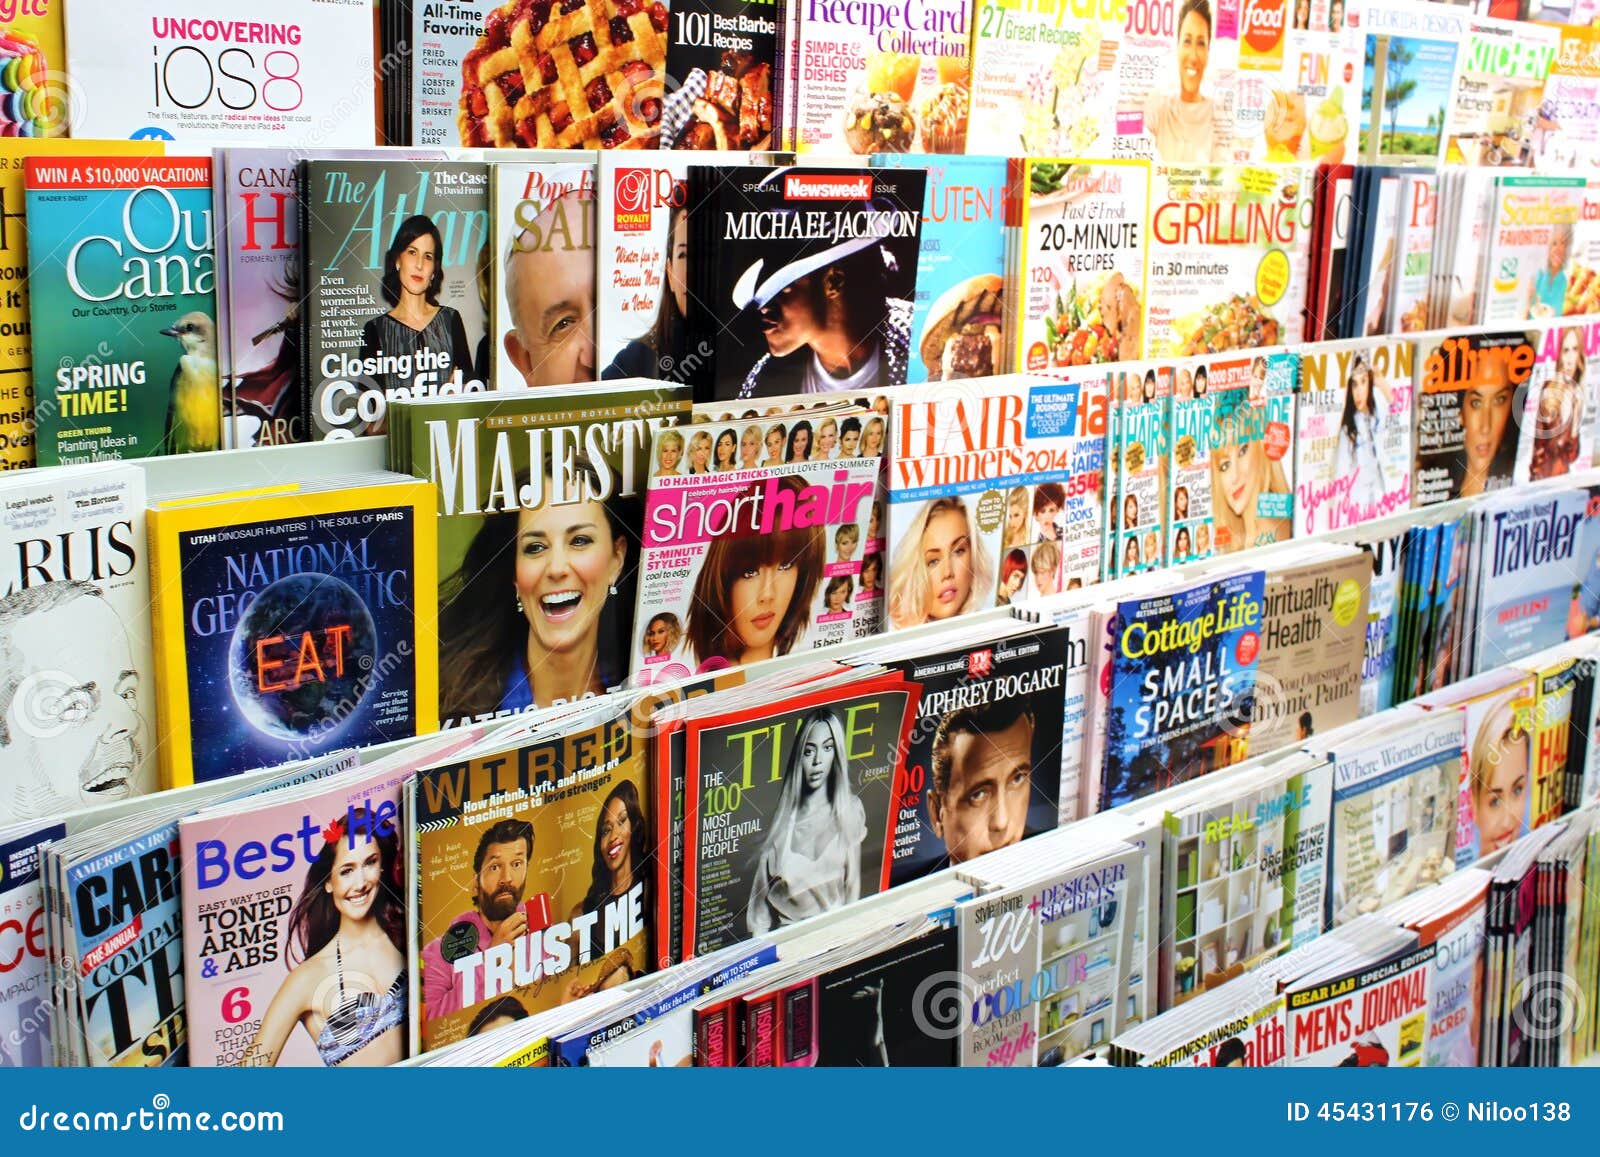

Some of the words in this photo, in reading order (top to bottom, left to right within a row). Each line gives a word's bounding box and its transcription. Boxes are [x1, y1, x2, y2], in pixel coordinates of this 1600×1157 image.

[423, 4, 483, 21] All-Time
[714, 14, 737, 32] Best
[807, 0, 900, 35] Recipe
[904, 0, 966, 35] Card
[980, 5, 1004, 39] 27
[1005, 23, 1036, 43] Great
[1037, 25, 1081, 47] Recipes
[1243, 1, 1285, 34] food
[1367, 7, 1419, 27] FLORIDA
[1423, 14, 1463, 34] DESIGN
[152, 16, 302, 45] UNCOVERING
[423, 20, 489, 38] Favorites
[674, 11, 711, 47] 101
[713, 33, 753, 51] Recipes
[877, 29, 966, 58] Collection
[423, 58, 458, 68] CHICKEN
[804, 54, 867, 71] DELICIOUS
[805, 40, 848, 55] SIMPLE
[1462, 36, 1555, 80] KITCHEN
[422, 78, 456, 88] LOBSTER
[804, 67, 847, 83] DISHES
[1298, 52, 1331, 85] FUN
[1458, 75, 1489, 93] Dream
[422, 108, 453, 117] BRISKET
[1456, 93, 1493, 113] Kitchens
[35, 167, 68, 184] WIN
[71, 168, 82, 184] A
[85, 166, 139, 184] $10,000
[142, 166, 209, 183] VACATION!
[323, 171, 366, 205] The
[520, 171, 571, 202] Pope
[742, 183, 780, 194] SPECIAL
[786, 176, 871, 199] Newsweek
[874, 184, 896, 194] ISSUE
[616, 213, 650, 224] ROYALTY
[724, 210, 829, 241] MICHAEL
[830, 210, 920, 244] JACKSON
[1061, 201, 1087, 221] Fast
[1098, 201, 1126, 221] Fresh
[1152, 202, 1296, 246] GRILLING
[1039, 222, 1138, 252] 20-MINUTE
[1031, 266, 1052, 284] 120
[1067, 253, 1115, 273] RECIPES
[1152, 262, 1164, 276] in
[1166, 262, 1182, 276] 30
[1184, 261, 1229, 276] minutes
[320, 275, 345, 286] Even
[320, 285, 369, 297] successful
[149, 301, 177, 313] Stories
[320, 295, 355, 306] women
[356, 294, 376, 306] lack
[320, 304, 386, 318] self-assurance
[342, 327, 365, 338] have
[56, 360, 147, 392] SPRING
[320, 351, 412, 380] Closing
[414, 346, 450, 371] the
[1423, 337, 1536, 394] allure
[56, 387, 128, 419] TIME!
[1031, 394, 1043, 405] THE
[1044, 392, 1075, 404] ULTIMATE
[1035, 402, 1068, 413] ROUNDUP
[1300, 388, 1336, 407] HAILEE
[521, 411, 574, 424] QUALITY
[581, 408, 617, 420] ROYAL
[897, 394, 1026, 461] HAIR
[57, 436, 98, 453] Planting
[673, 474, 700, 487] HAIR
[701, 472, 734, 486] MAGIC
[735, 468, 769, 482] TRICKS
[797, 462, 818, 475] LOVE
[838, 458, 876, 470] SUMMER
[896, 447, 1023, 491] winners
[1025, 448, 1068, 474] 2014
[1065, 507, 1093, 524] LOOKS
[1066, 498, 1084, 511] NEW
[1298, 466, 1360, 536] Young
[190, 533, 217, 546] UTAH
[217, 527, 264, 543] DINOSAUR
[264, 521, 307, 536] HUNTERS
[336, 515, 360, 529] SOUL
[375, 511, 405, 524] PARIS
[1493, 500, 1584, 578] Traveler
[224, 537, 378, 592] NATIONAL
[647, 556, 692, 572] STYLES!
[648, 545, 704, 561] 5-MINUTE
[1120, 618, 1214, 660] Cottage
[1213, 591, 1260, 634] Life
[1267, 610, 1322, 650] Health
[255, 623, 353, 696] EAT
[1018, 643, 1040, 656] EDITION
[995, 663, 1063, 702] BOGART
[1142, 647, 1233, 703] SMALL
[1315, 673, 1358, 706] Pain?
[1133, 676, 1236, 740] SPACES
[292, 755, 357, 787] RENEGADE
[422, 719, 633, 815] WIRED
[1338, 756, 1379, 782] Where
[1379, 740, 1424, 774] Women
[1424, 730, 1463, 754] Create
[463, 795, 488, 814] How
[489, 787, 529, 808] Airbnb,
[529, 778, 556, 798] Lyft,
[556, 773, 577, 789] and
[577, 762, 605, 783] Tinder
[704, 771, 724, 788] THE
[463, 801, 514, 827] teaching
[566, 773, 612, 800] strangers
[703, 782, 742, 818] 100
[1205, 810, 1254, 845] REAL
[1255, 783, 1313, 826] SIMPLE
[702, 812, 732, 833] MOST
[702, 818, 762, 847] INFLUENTIAL
[74, 840, 147, 881] AMERICAN
[196, 815, 321, 891] Best
[701, 838, 739, 861] PEOPLE
[1259, 830, 1326, 874] ORGANIZING
[1267, 847, 1324, 884] MAKEOVER
[1041, 863, 1126, 904] DESIGNER
[198, 899, 228, 914] EASY
[198, 895, 293, 934] TONED
[1041, 883, 1116, 926] SECRETS
[104, 925, 138, 957] ANNUAL
[199, 919, 278, 958] ARMS
[453, 910, 598, 1009] TRUST
[604, 881, 644, 955] ME
[971, 904, 1035, 969] 100
[201, 957, 219, 980] &
[224, 942, 278, 973] ABS
[1292, 987, 1329, 1007] GEAR
[1331, 978, 1356, 998] LAB
[1360, 963, 1400, 987] SPECIAL
[1400, 946, 1436, 970] EDITION
[971, 951, 1089, 1029] COLOUR
[972, 968, 1021, 998] perfect
[220, 986, 252, 1024] 6
[1294, 998, 1354, 1059] MEN'S
[1354, 966, 1428, 1037] JOURNAL
[215, 1020, 262, 1042] FOODS
[986, 1022, 1037, 1067] style
[1169, 1035, 1209, 1066] FITNESS
[1207, 1016, 1249, 1047] AWARDS
